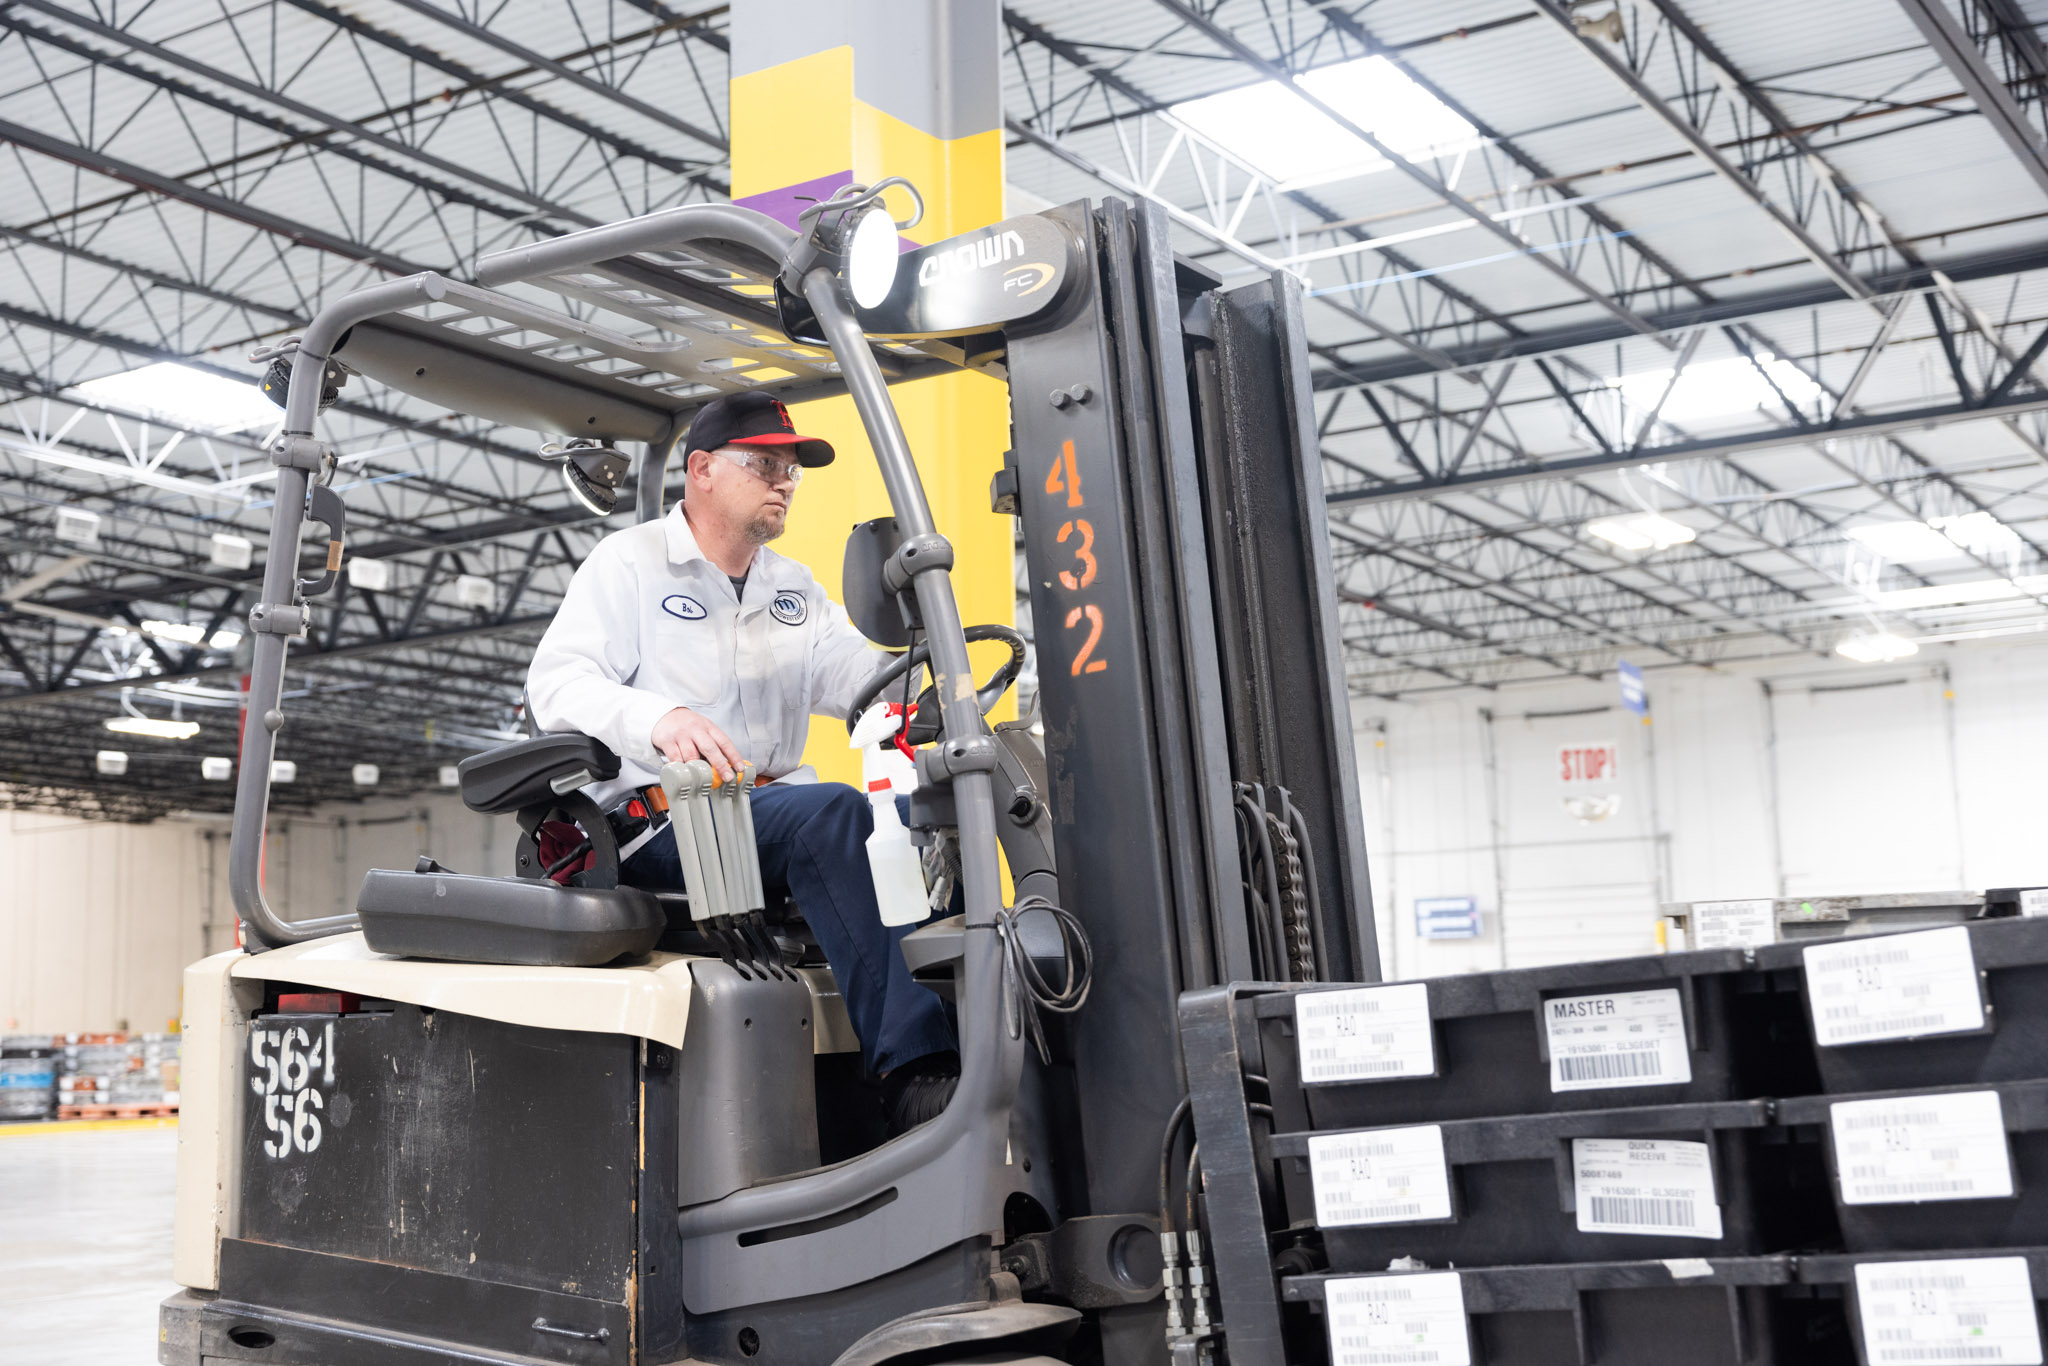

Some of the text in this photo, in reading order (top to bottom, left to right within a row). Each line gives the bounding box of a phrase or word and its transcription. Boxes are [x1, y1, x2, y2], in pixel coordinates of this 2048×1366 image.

[918, 230, 1025, 287] CROWN
[1003, 273, 1033, 292] FC
[769, 399, 794, 429] B
[1045, 440, 1107, 676] 432
[1554, 999, 1616, 1019] MASTER
[251, 1022, 335, 1094] 564
[264, 1087, 324, 1159] 56
[1628, 1141, 1657, 1150] QUICK
[1629, 1151, 1667, 1161] RECEIVE
